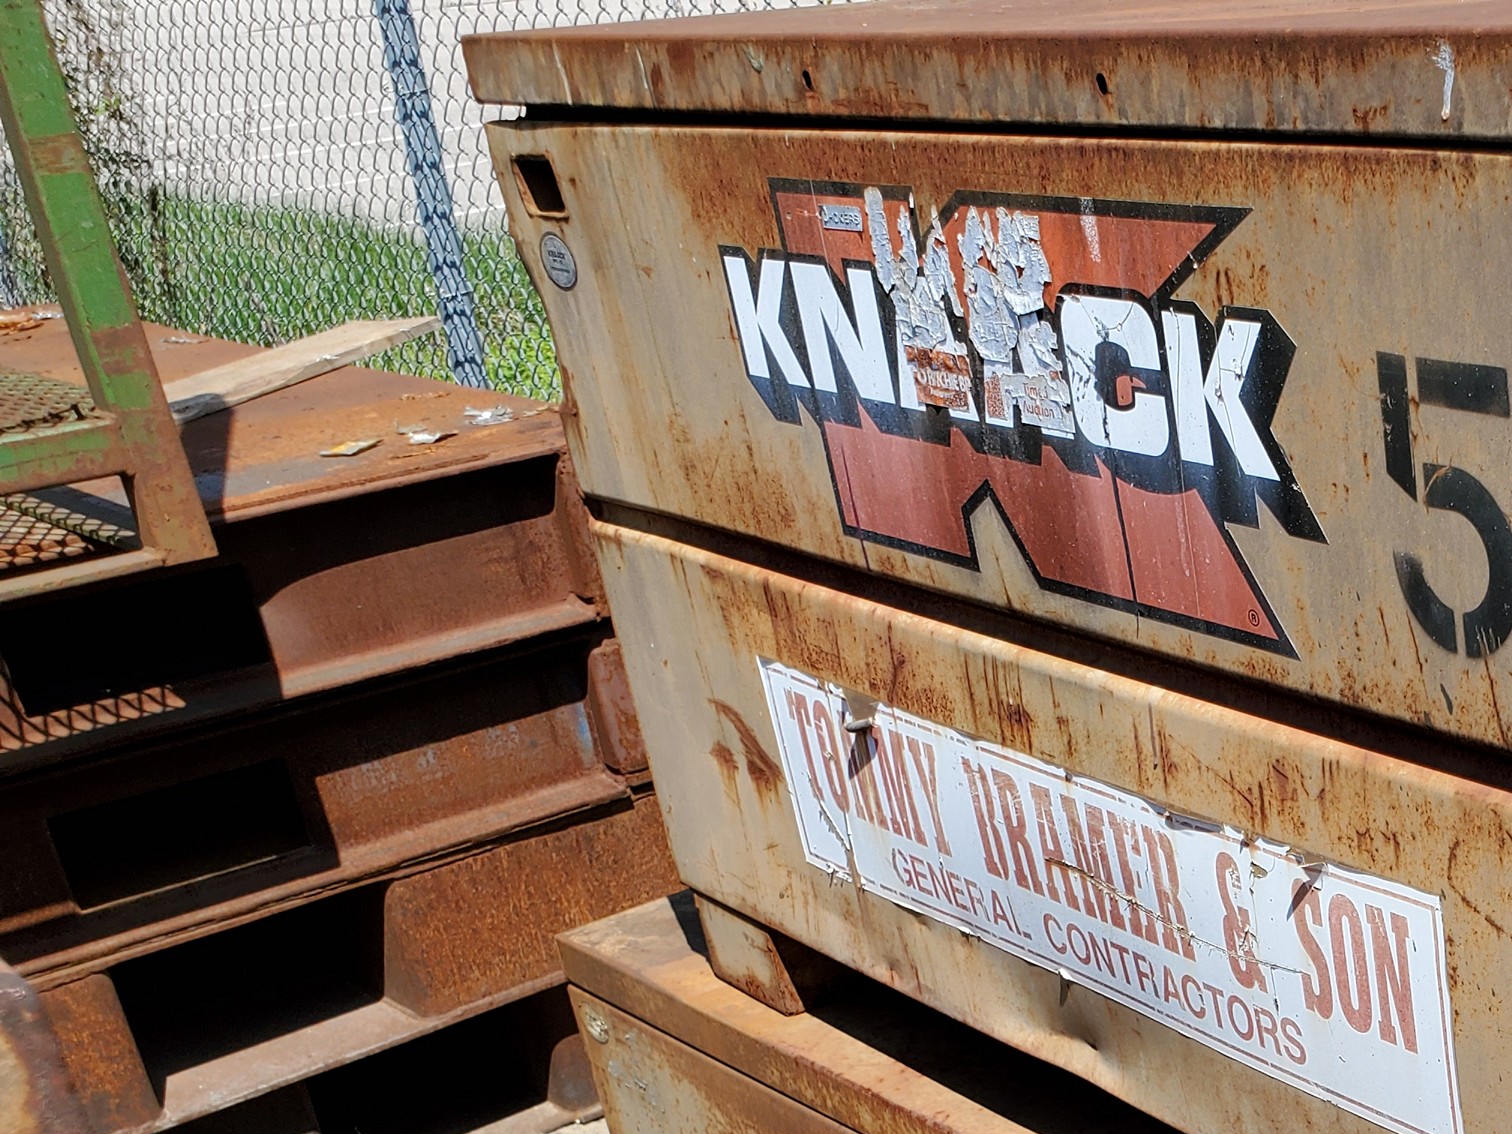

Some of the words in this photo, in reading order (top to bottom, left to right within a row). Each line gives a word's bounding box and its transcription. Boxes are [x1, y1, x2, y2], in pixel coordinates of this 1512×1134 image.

[891, 847, 1033, 941] GENERAL
[1043, 912, 1309, 1067] CONTRACTORS
[1215, 851, 1268, 996] &
[1291, 876, 1419, 1055] SON
